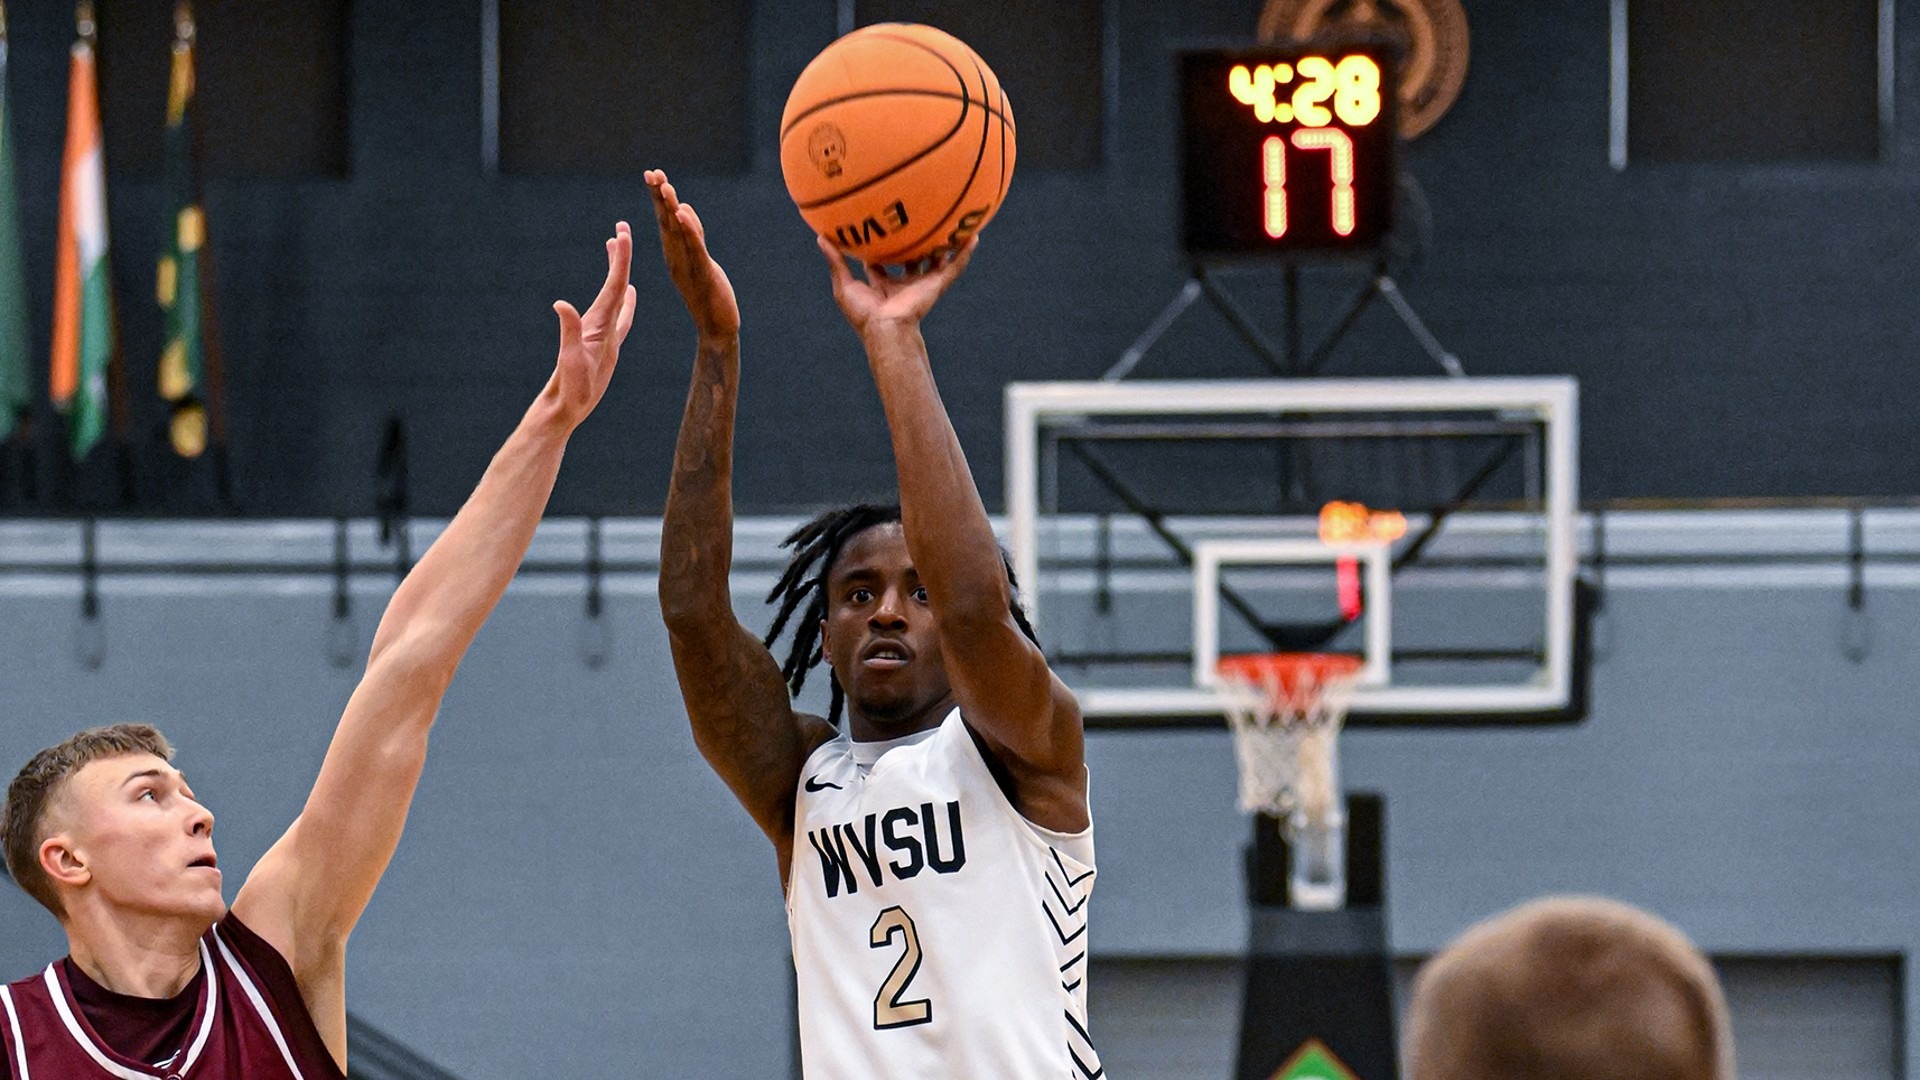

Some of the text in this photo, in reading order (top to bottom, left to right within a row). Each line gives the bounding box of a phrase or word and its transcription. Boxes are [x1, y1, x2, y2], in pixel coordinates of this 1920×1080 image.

[1229, 55, 1381, 127] 4:28
[1263, 128, 1355, 238] 17
[808, 800, 966, 898] WVSU
[870, 904, 932, 1030] 2
